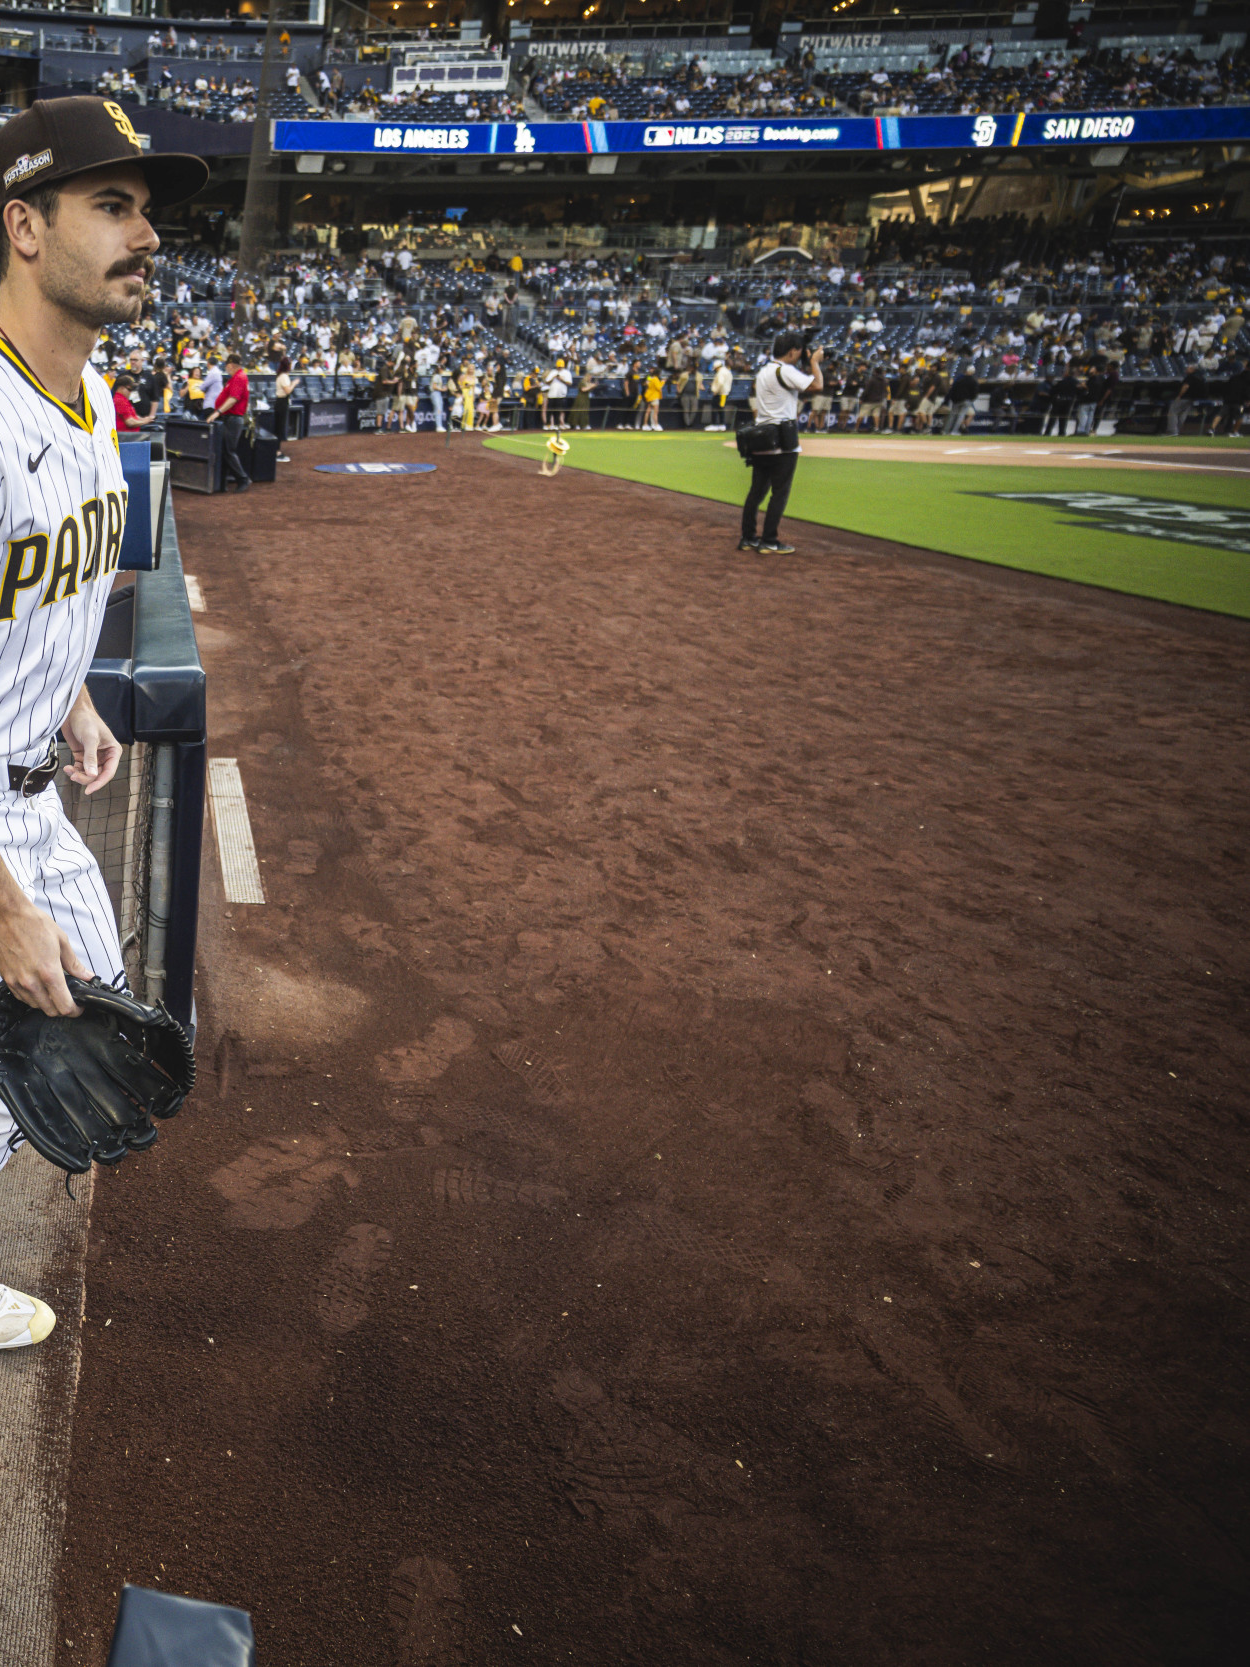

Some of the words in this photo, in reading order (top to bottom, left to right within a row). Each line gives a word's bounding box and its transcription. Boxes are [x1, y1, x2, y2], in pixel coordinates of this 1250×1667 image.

[528, 42, 607, 57] CUTWATER
[674, 126, 724, 145] NLDS
[763, 127, 839, 142] Booking.com
[1043, 119, 1080, 139] SAN
[1081, 116, 1135, 138] DIEGO
[374, 128, 402, 148] LOS
[403, 128, 469, 149] ANGELES
